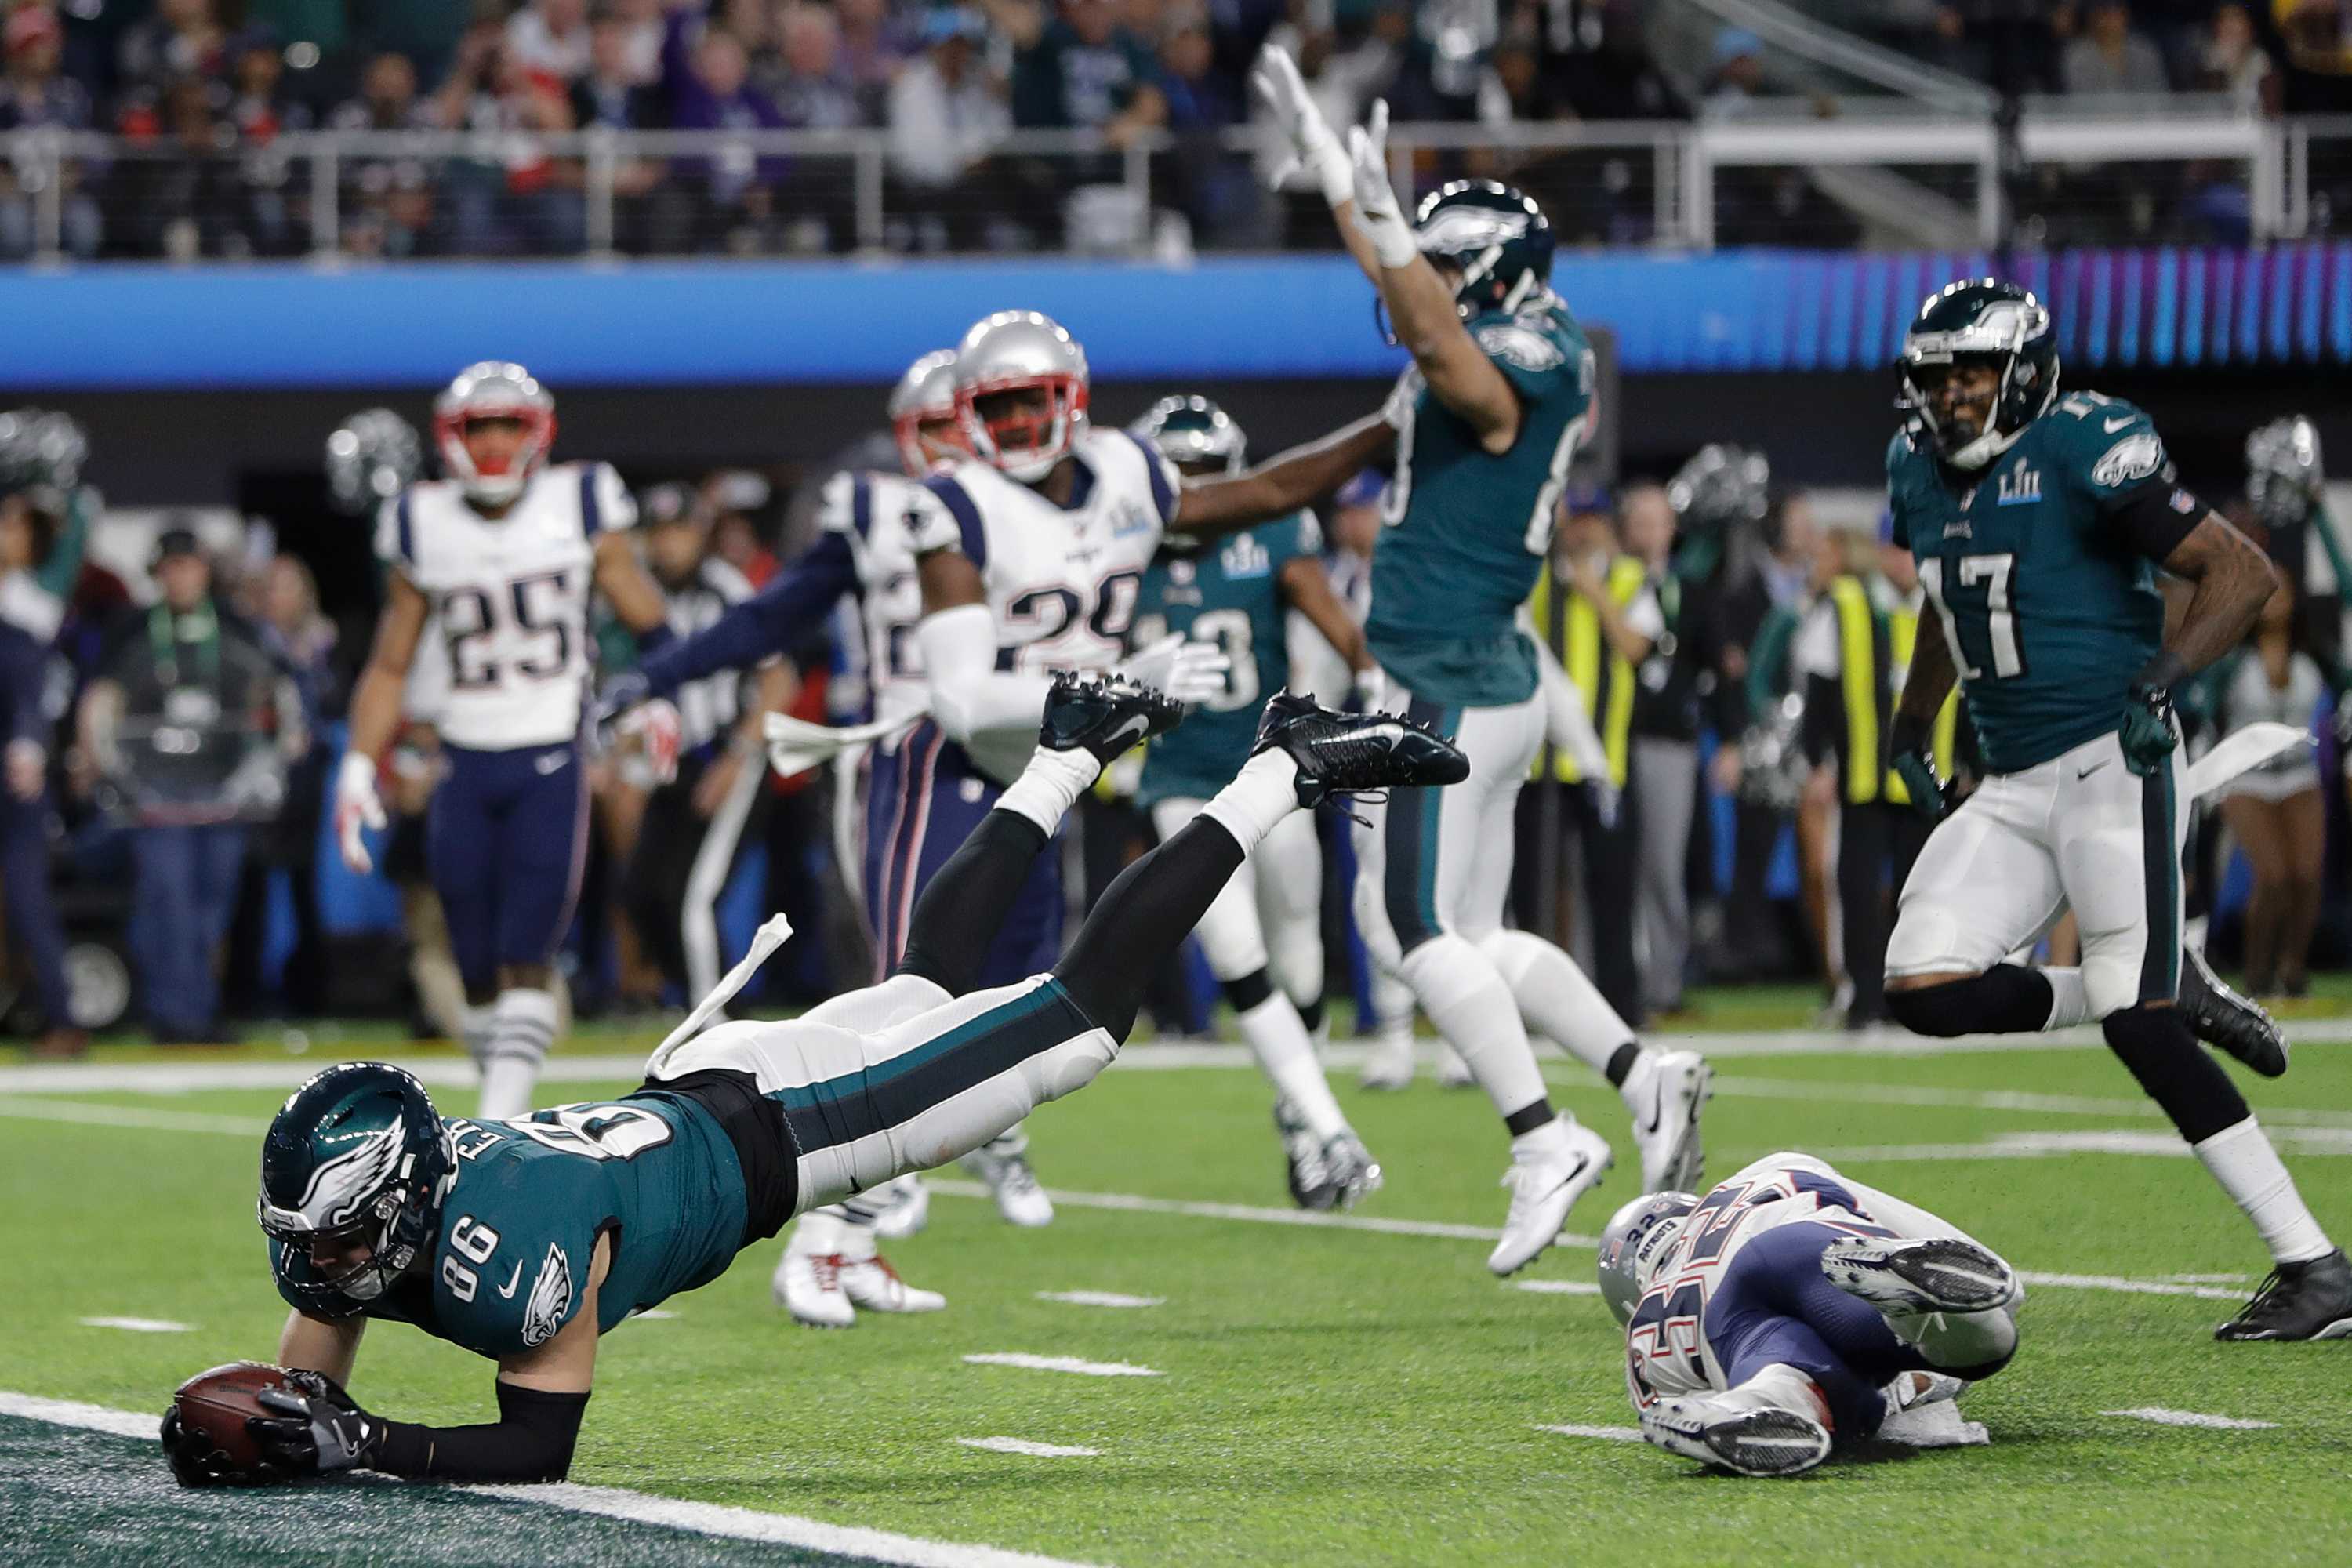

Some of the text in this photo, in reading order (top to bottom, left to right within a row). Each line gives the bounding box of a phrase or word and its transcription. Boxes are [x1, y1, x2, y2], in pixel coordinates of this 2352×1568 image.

[444, 571, 569, 693] 25
[1918, 553, 2023, 680] 17
[442, 1215, 499, 1302] 86
[1627, 1214, 1657, 1248] 32
[1639, 1220, 1677, 1263] PATRIOTS
